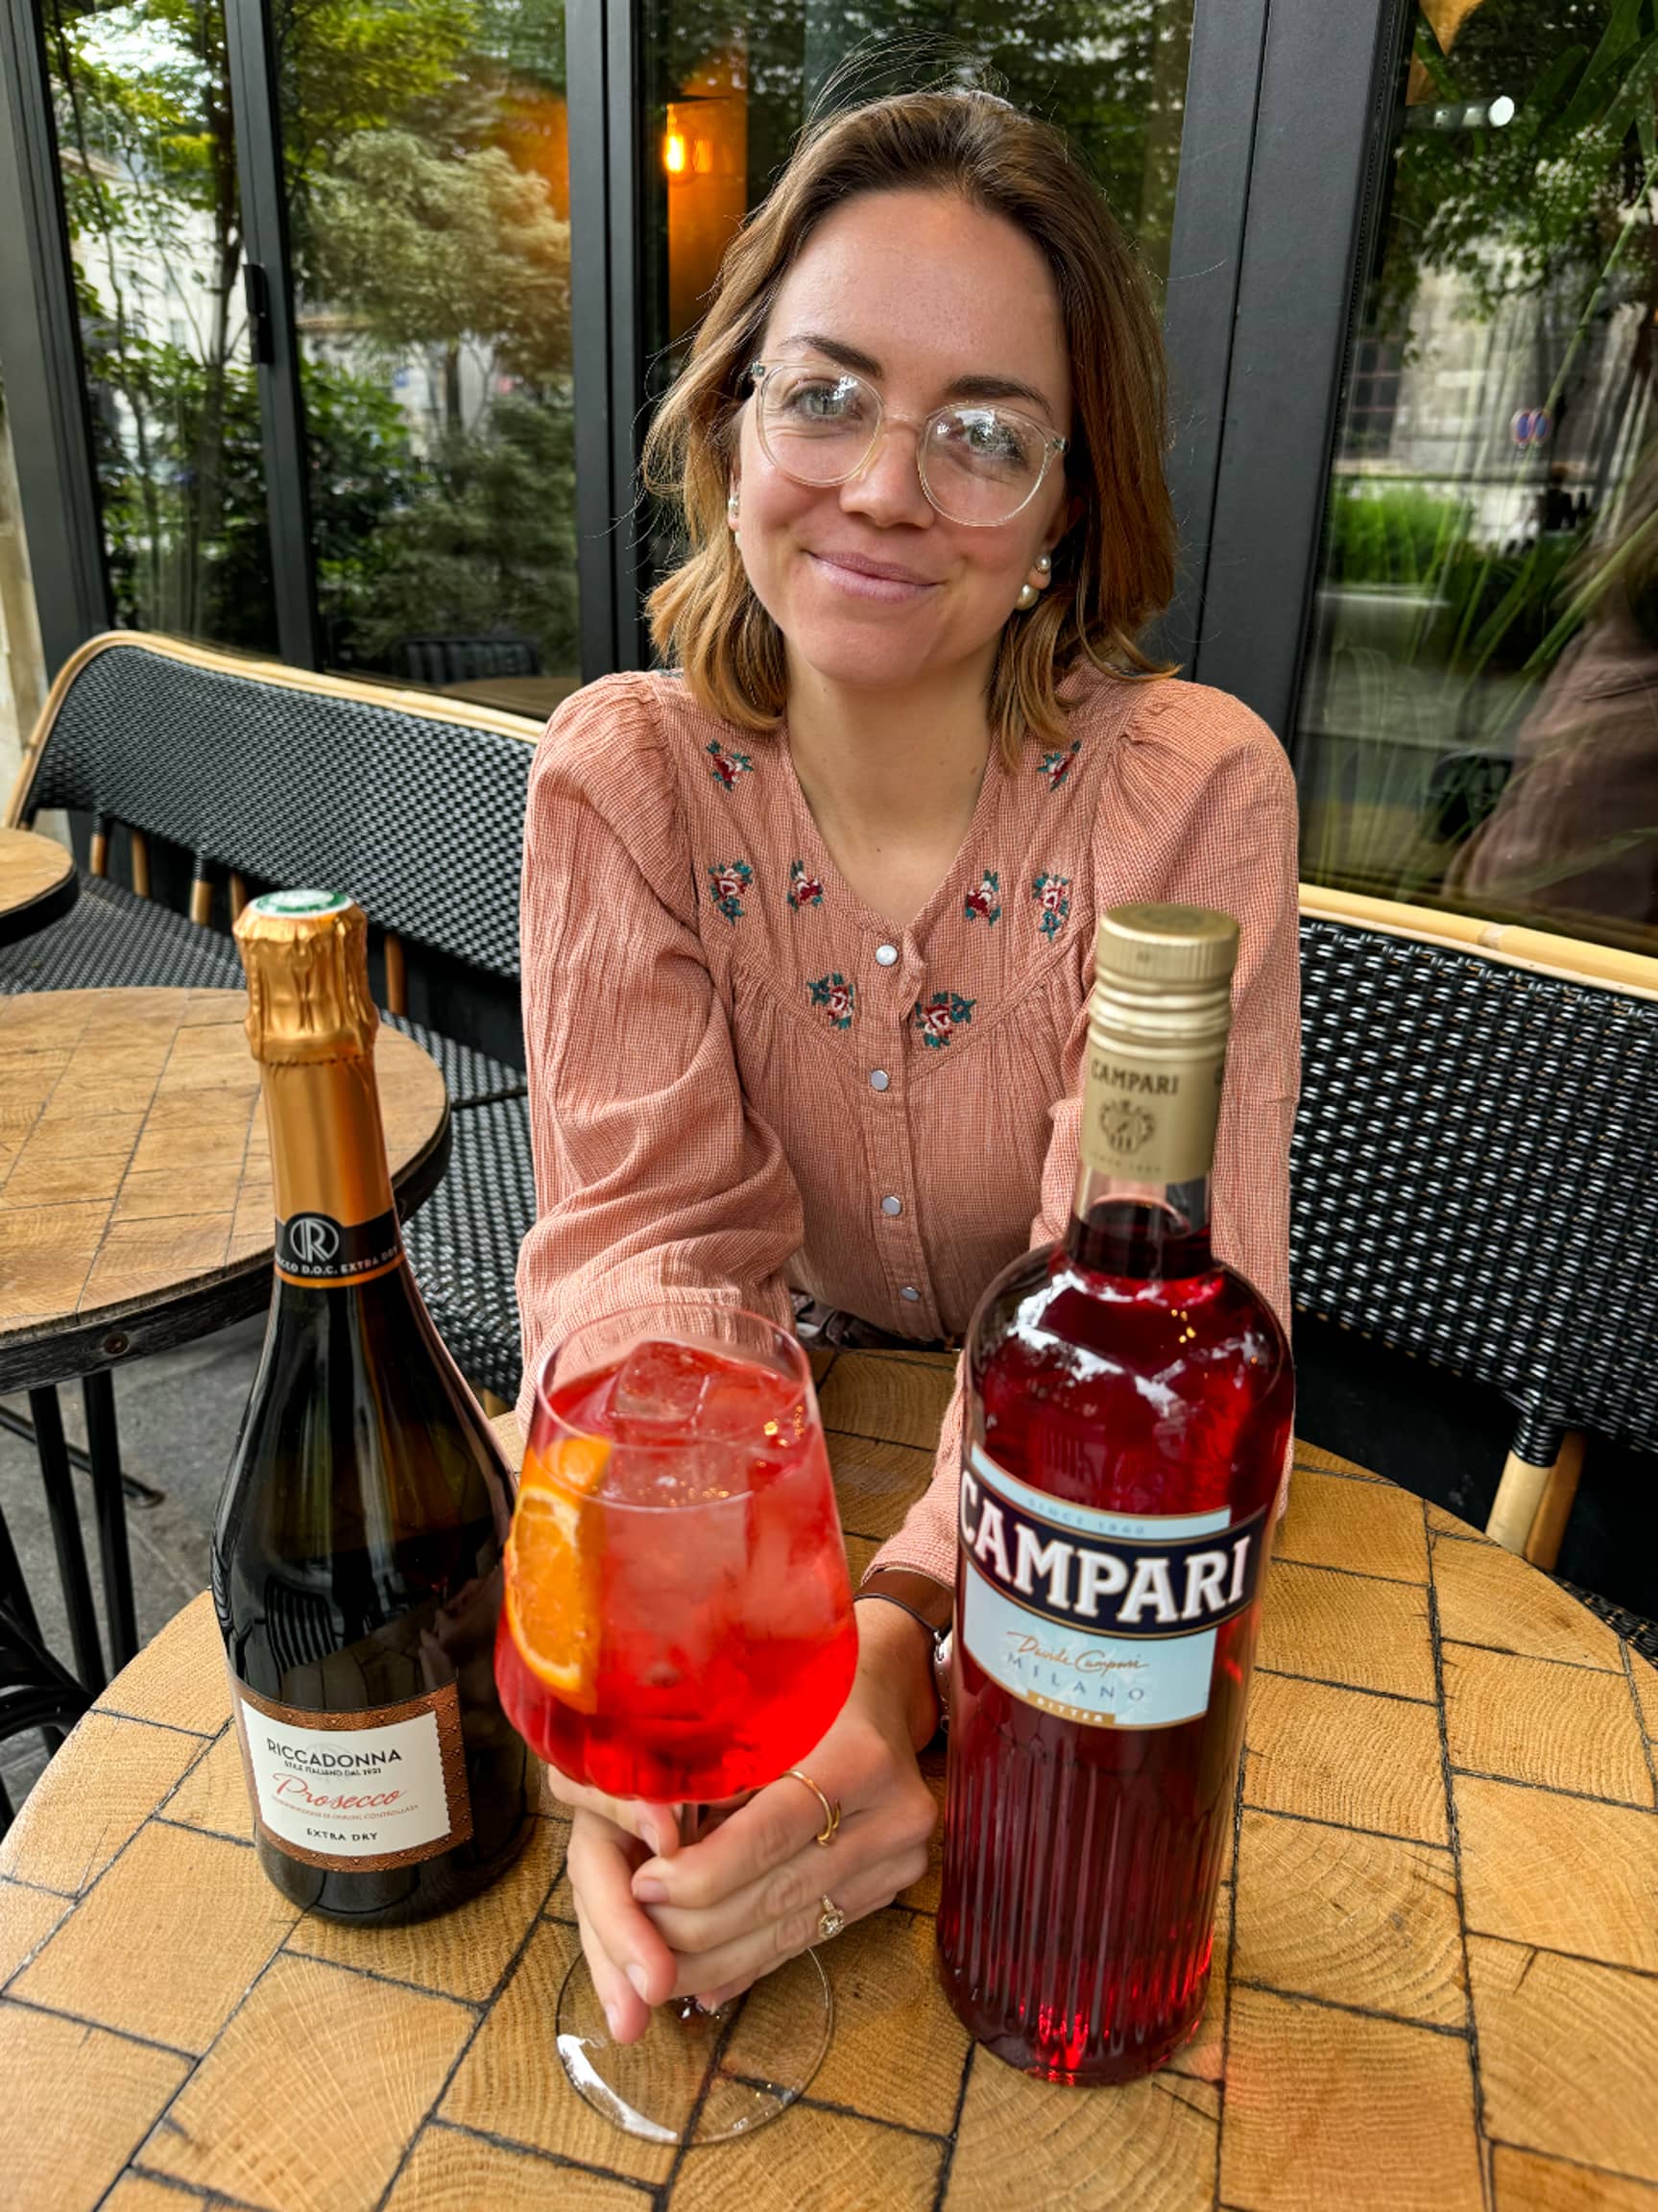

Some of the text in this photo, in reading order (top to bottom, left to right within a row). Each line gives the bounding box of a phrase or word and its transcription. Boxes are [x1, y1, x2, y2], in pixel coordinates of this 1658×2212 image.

[1091, 1059, 1179, 1094] CAMPARI
[340, 1257, 379, 1274] EXTRA
[960, 1470, 1251, 1623] CAMPARI
[1007, 1652, 1145, 1701] MILANO
[266, 1737, 402, 1768] RICCADONNA
[272, 1772, 408, 1811] Prosecco
[306, 1827, 378, 1842] EXTRA DRY
